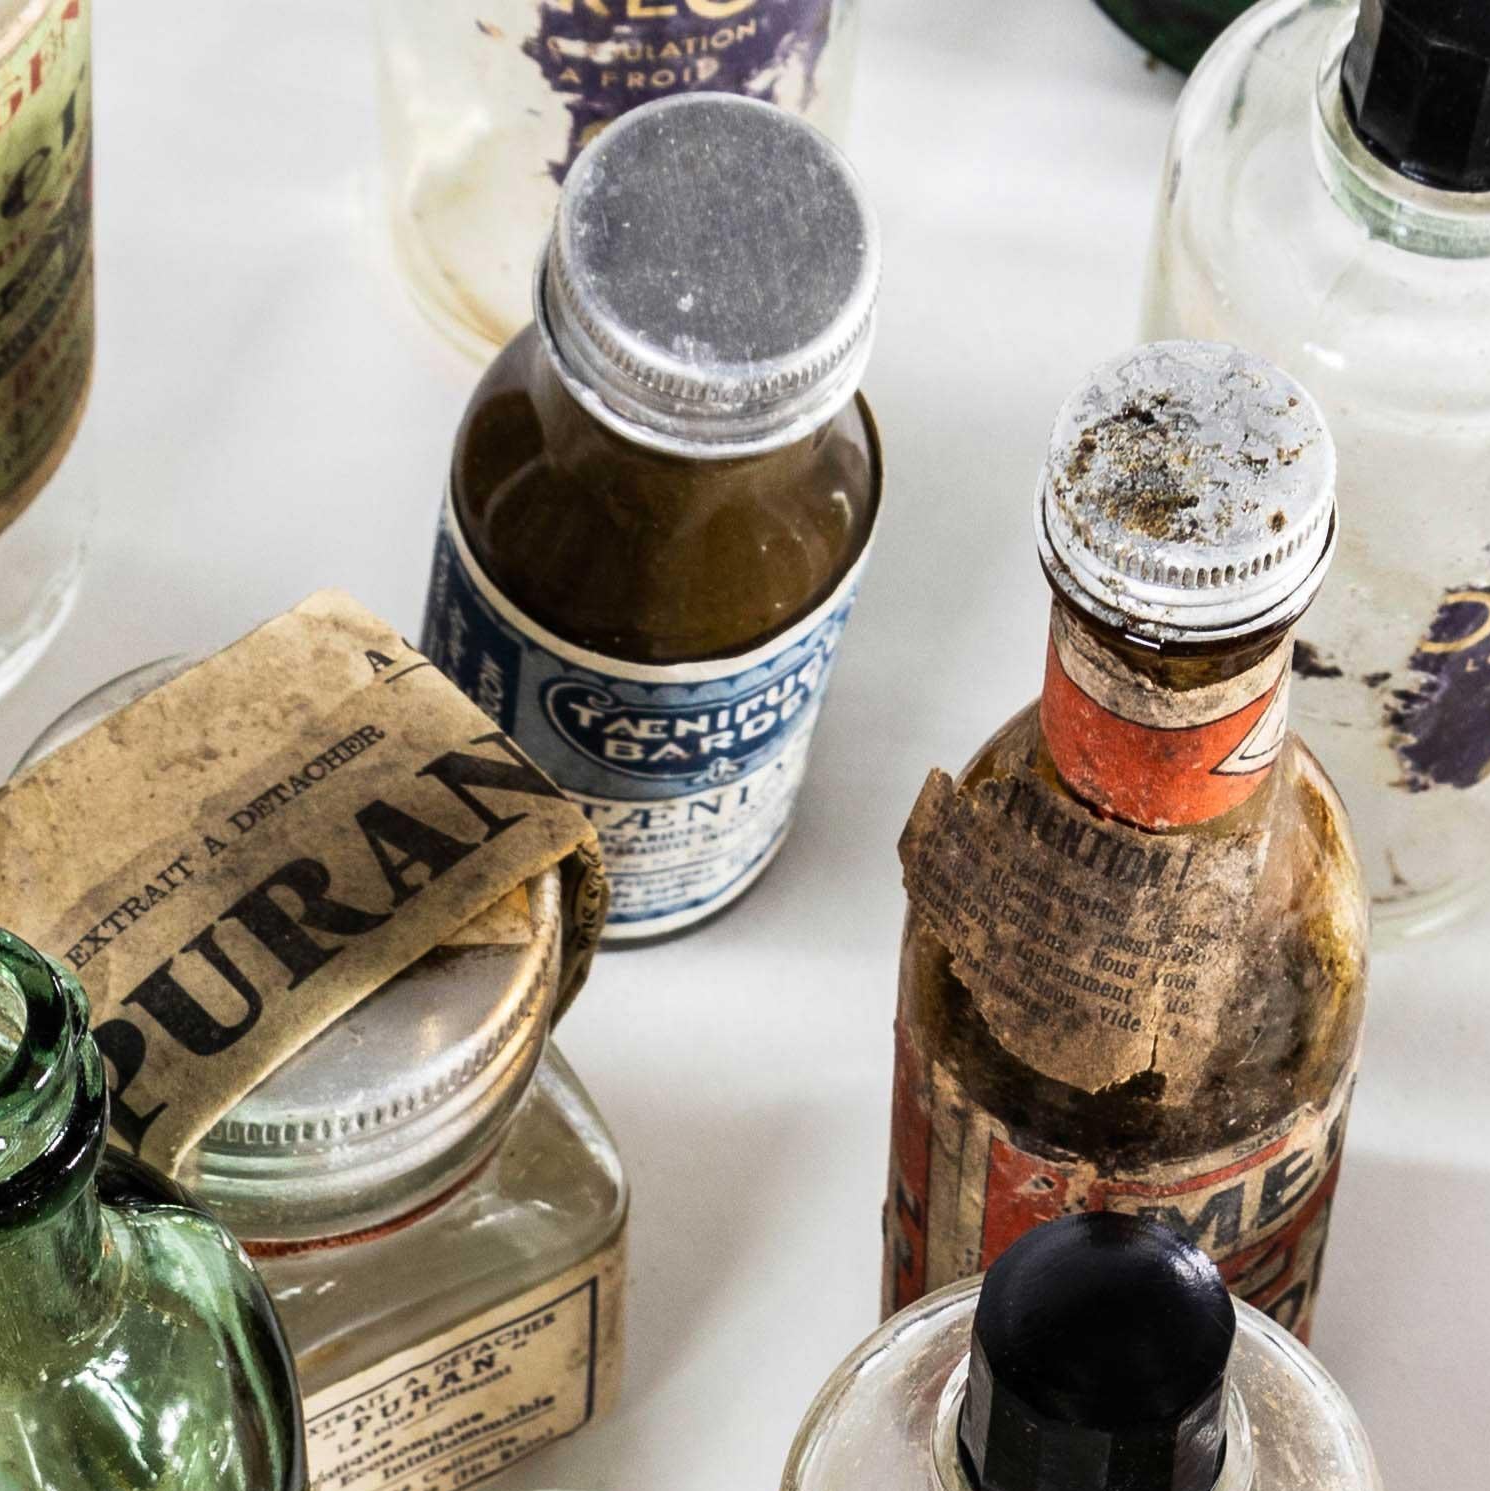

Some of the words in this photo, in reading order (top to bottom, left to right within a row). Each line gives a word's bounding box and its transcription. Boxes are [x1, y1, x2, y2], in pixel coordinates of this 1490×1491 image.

[62, 852, 195, 971] EXTRAIT
[206, 836, 229, 858] A
[227, 723, 387, 835] DETACHER
[97, 731, 568, 1157] PURAN
[1092, 949, 1137, 982] Nous
[1098, 1003, 1142, 1035] vide
[309, 1393, 387, 1438] XTRAIT
[353, 1352, 499, 1434] PURAN
